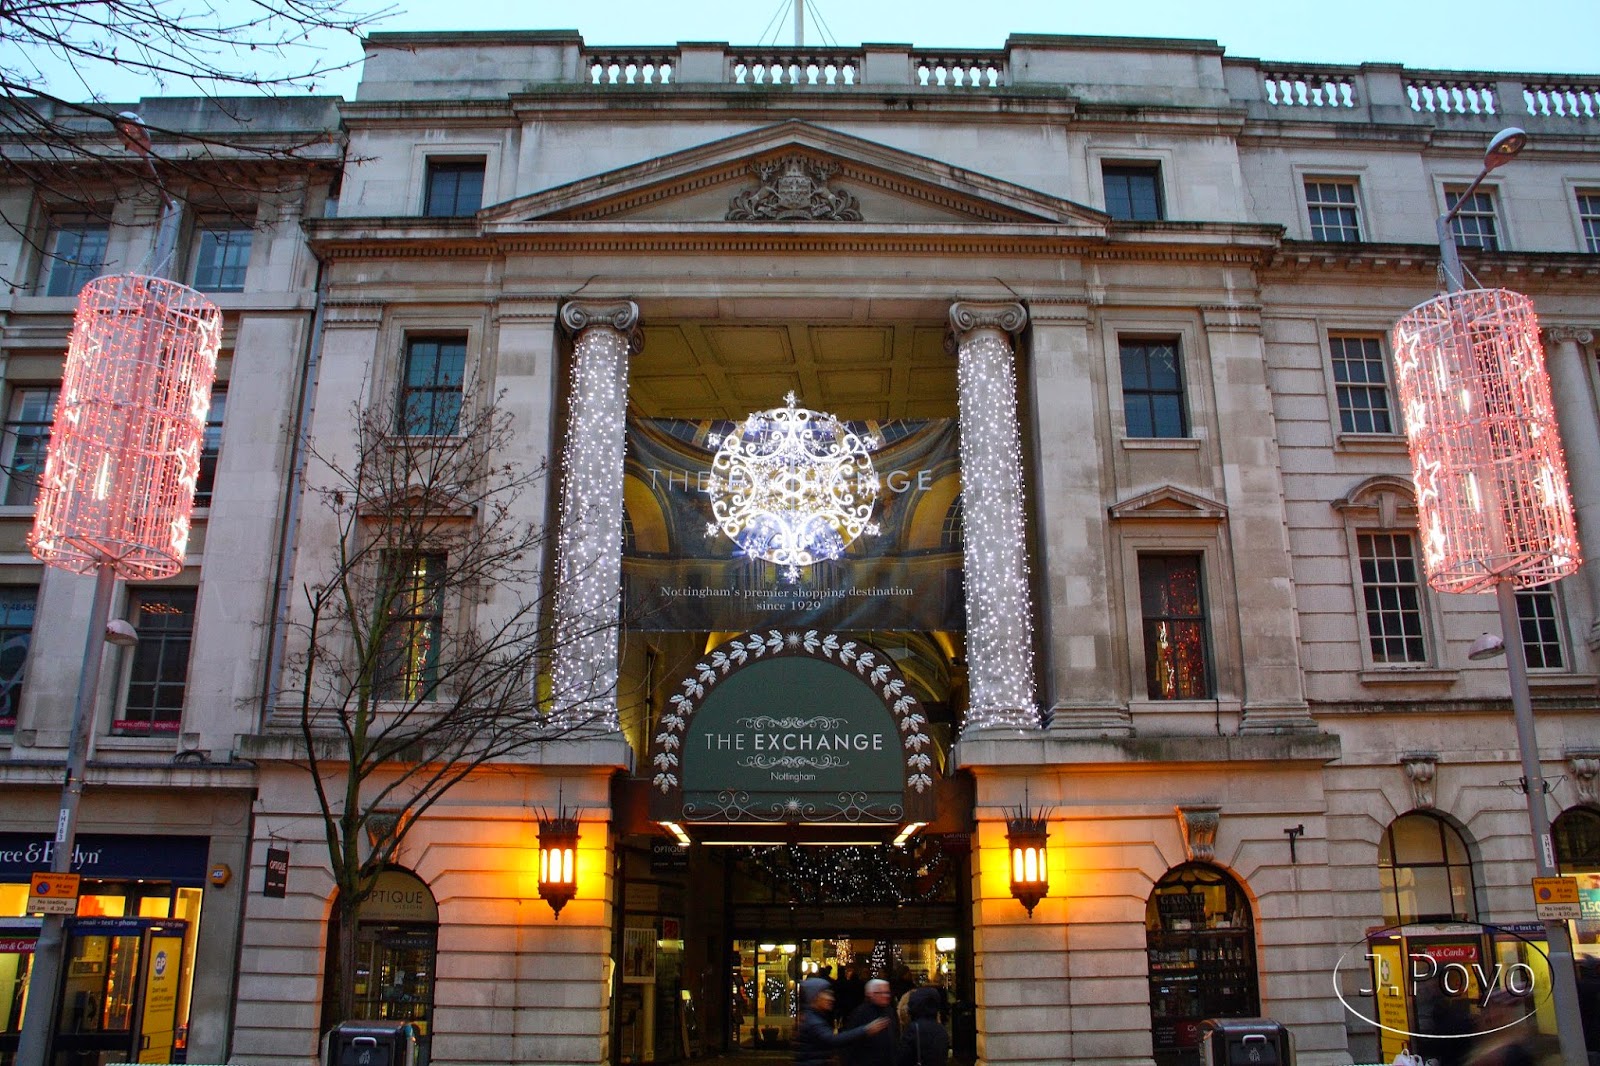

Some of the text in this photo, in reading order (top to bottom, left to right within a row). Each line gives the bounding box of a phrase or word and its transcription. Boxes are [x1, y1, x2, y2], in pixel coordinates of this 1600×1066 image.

[647, 468, 712, 493] THE
[660, 585, 914, 599] Nottingham's premier shopping destination
[756, 600, 822, 611] since 1929
[704, 733, 884, 751] THE EXCHANGE
[770, 771, 816, 783] Nottingham
[25, 842, 42, 863] &
[41, 841, 99, 870] Elyn
[1443, 948, 1465, 957] Cards
